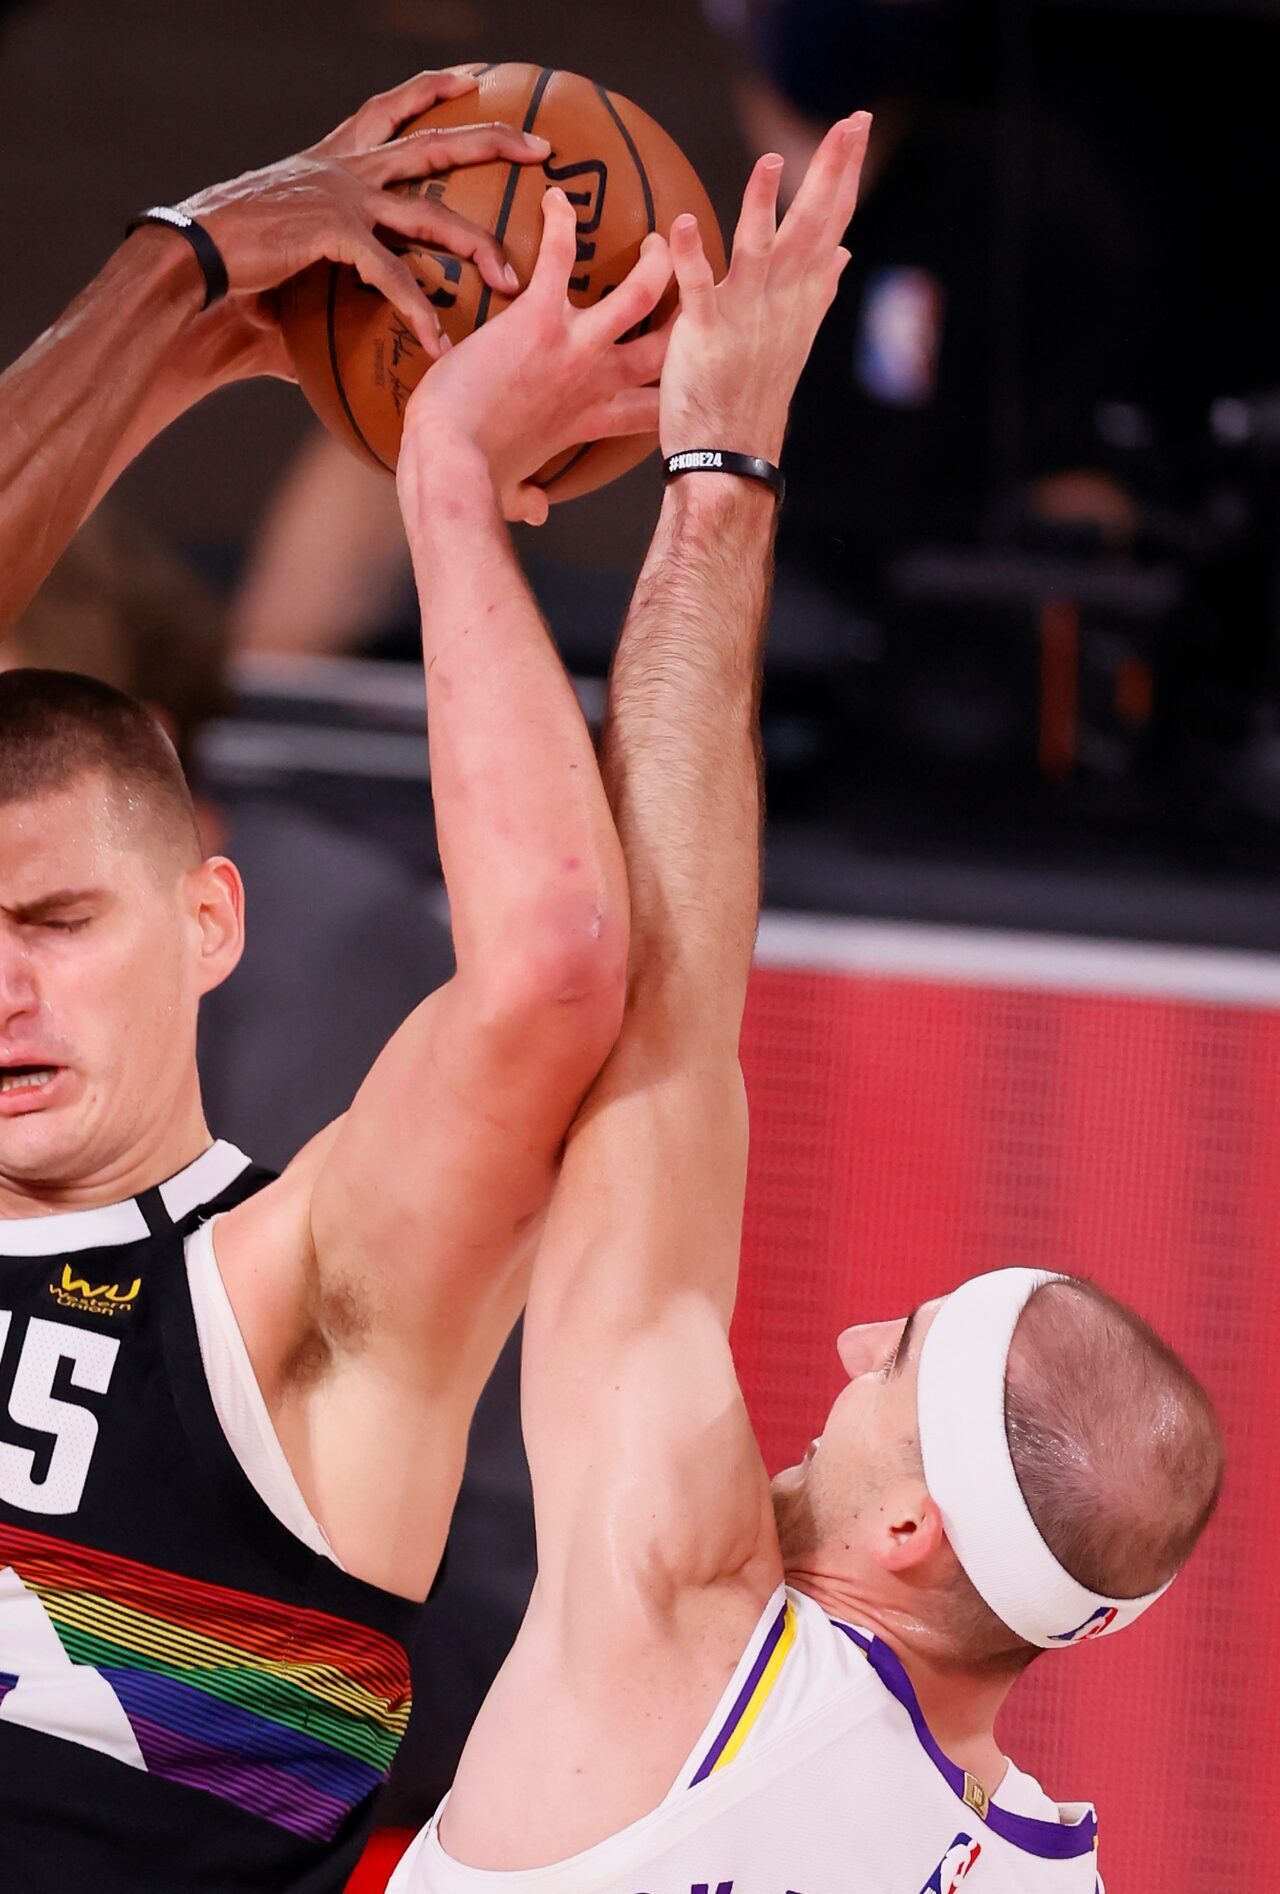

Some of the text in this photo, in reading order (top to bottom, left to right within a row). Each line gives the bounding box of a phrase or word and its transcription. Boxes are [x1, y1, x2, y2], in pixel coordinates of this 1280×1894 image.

[668, 452, 723, 473] #KOBE24
[49, 1284, 131, 1312] Western
[57, 1297, 113, 1316] Union
